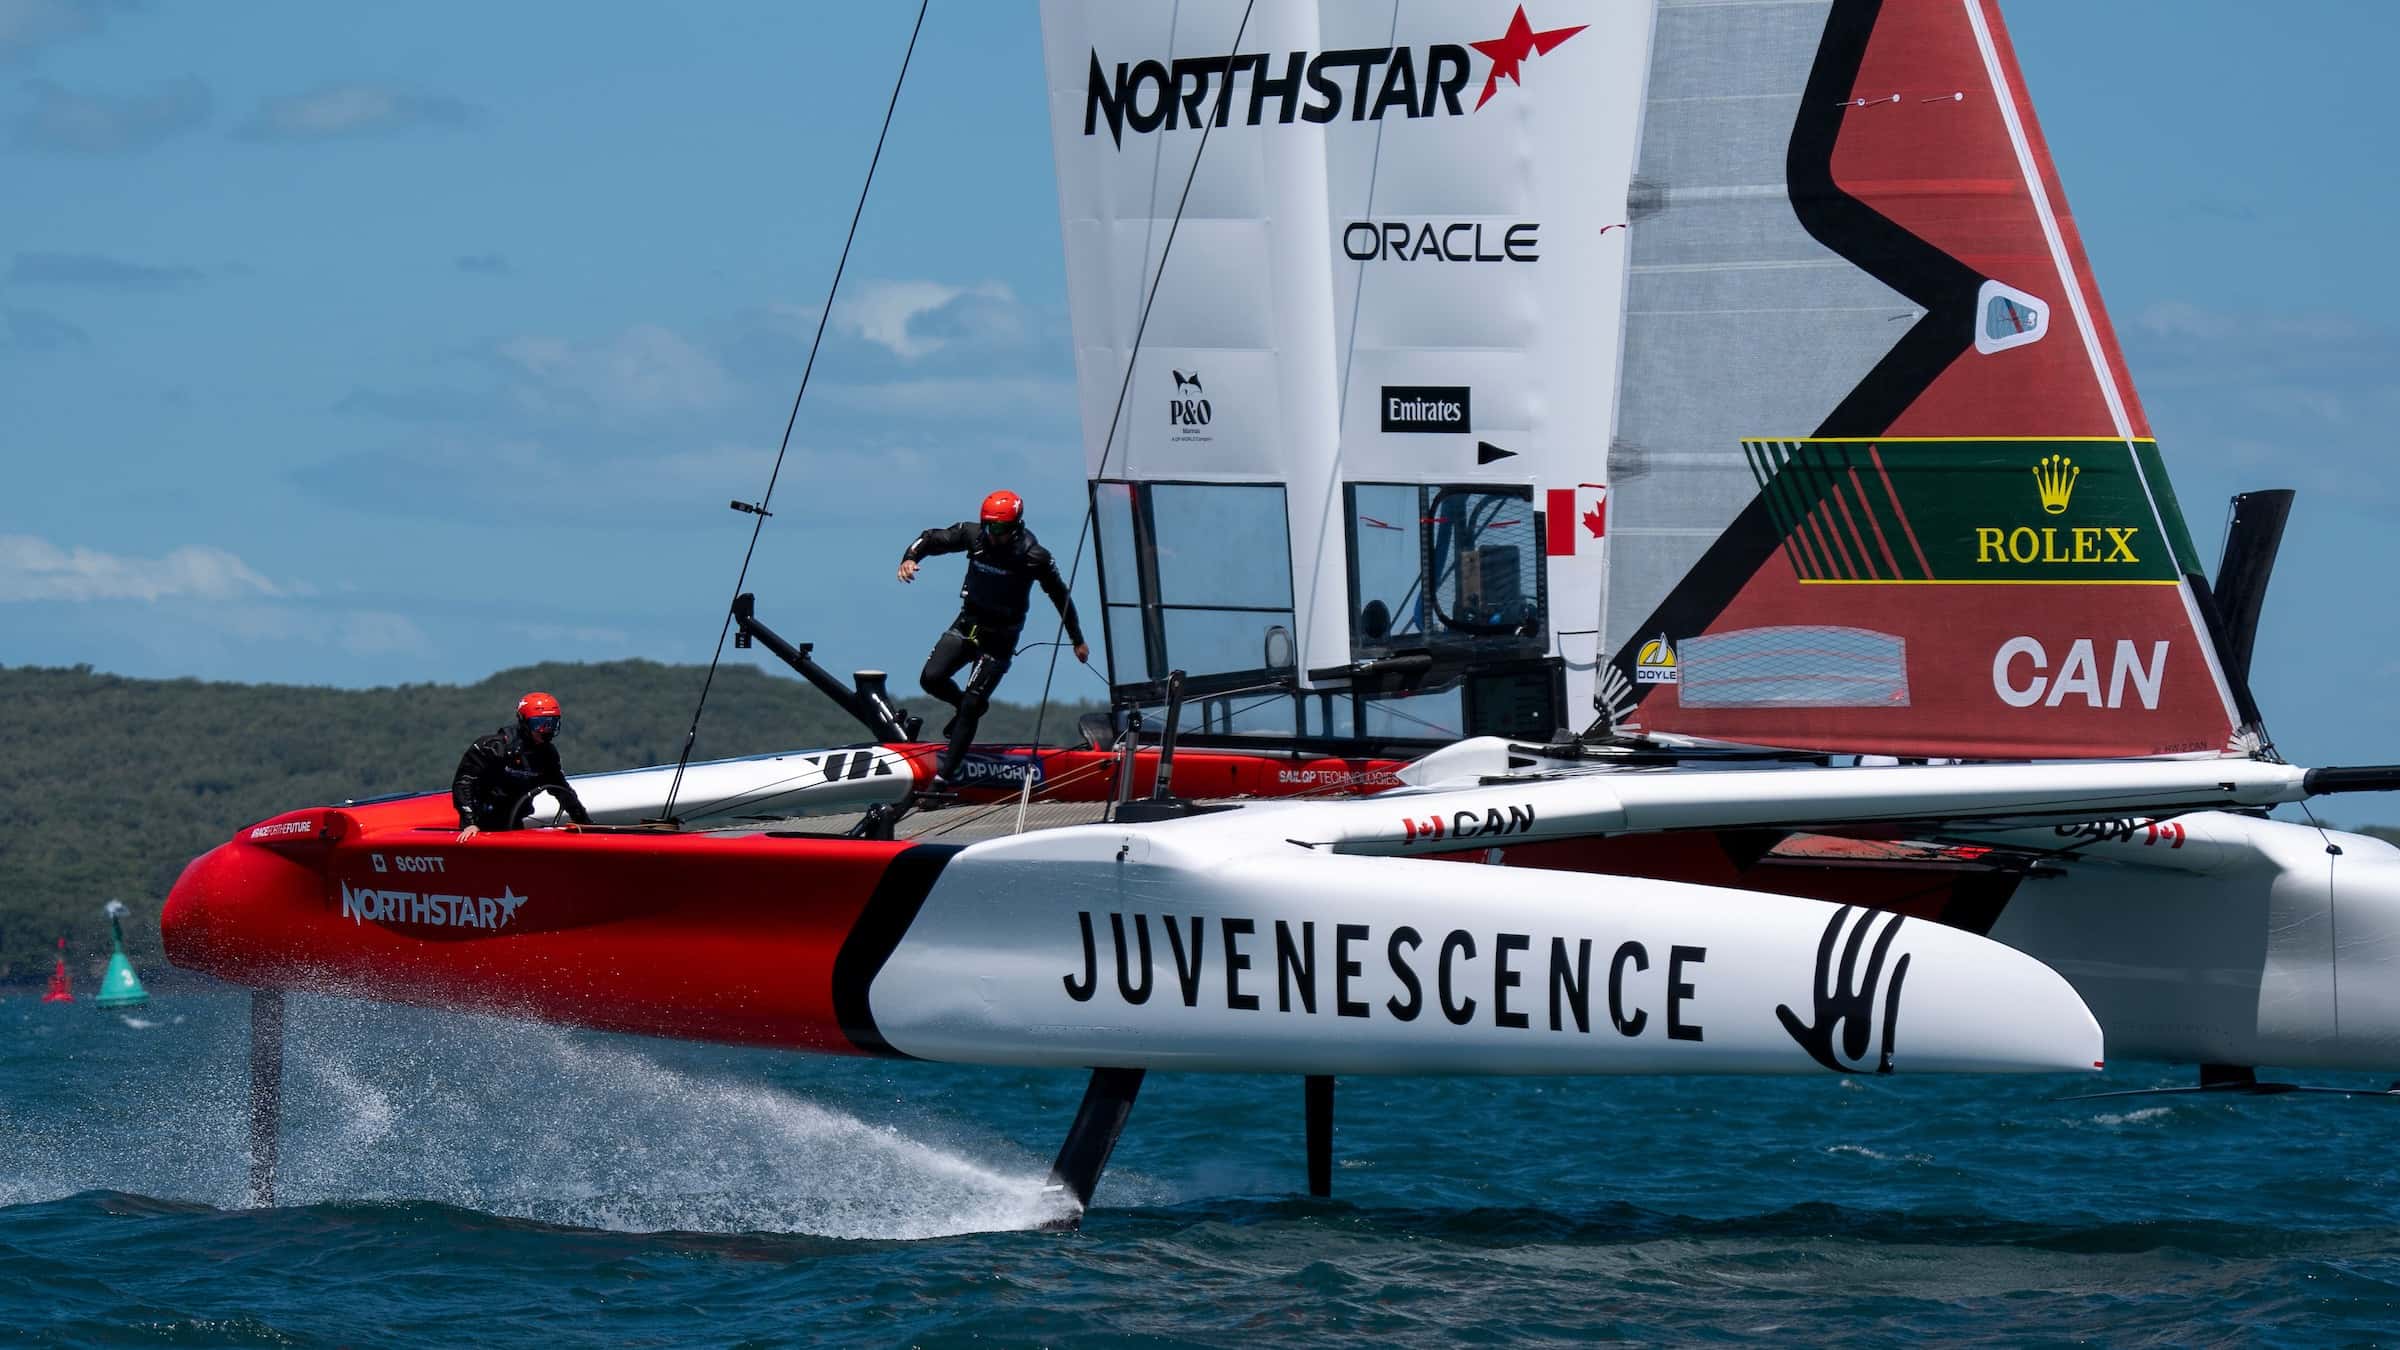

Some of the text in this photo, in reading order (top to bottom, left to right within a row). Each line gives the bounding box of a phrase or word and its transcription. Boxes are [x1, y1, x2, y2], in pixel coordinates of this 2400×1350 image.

[1084, 44, 1471, 153] NORTHSTAR
[1343, 221, 1541, 262] ORACLE
[1170, 399, 1211, 425] P&O
[1389, 396, 1462, 421] Emirates
[1975, 526, 2140, 564] ROLEX
[1638, 670, 1676, 680] DOYLE
[1992, 635, 2171, 710] CAN
[967, 762, 1042, 780] DP WORLD
[1452, 803, 1535, 838] CAN
[395, 855, 445, 873] SCOTT
[341, 880, 497, 929] NORTHSTAR
[1063, 911, 1707, 1042] JUVENESCENCE
